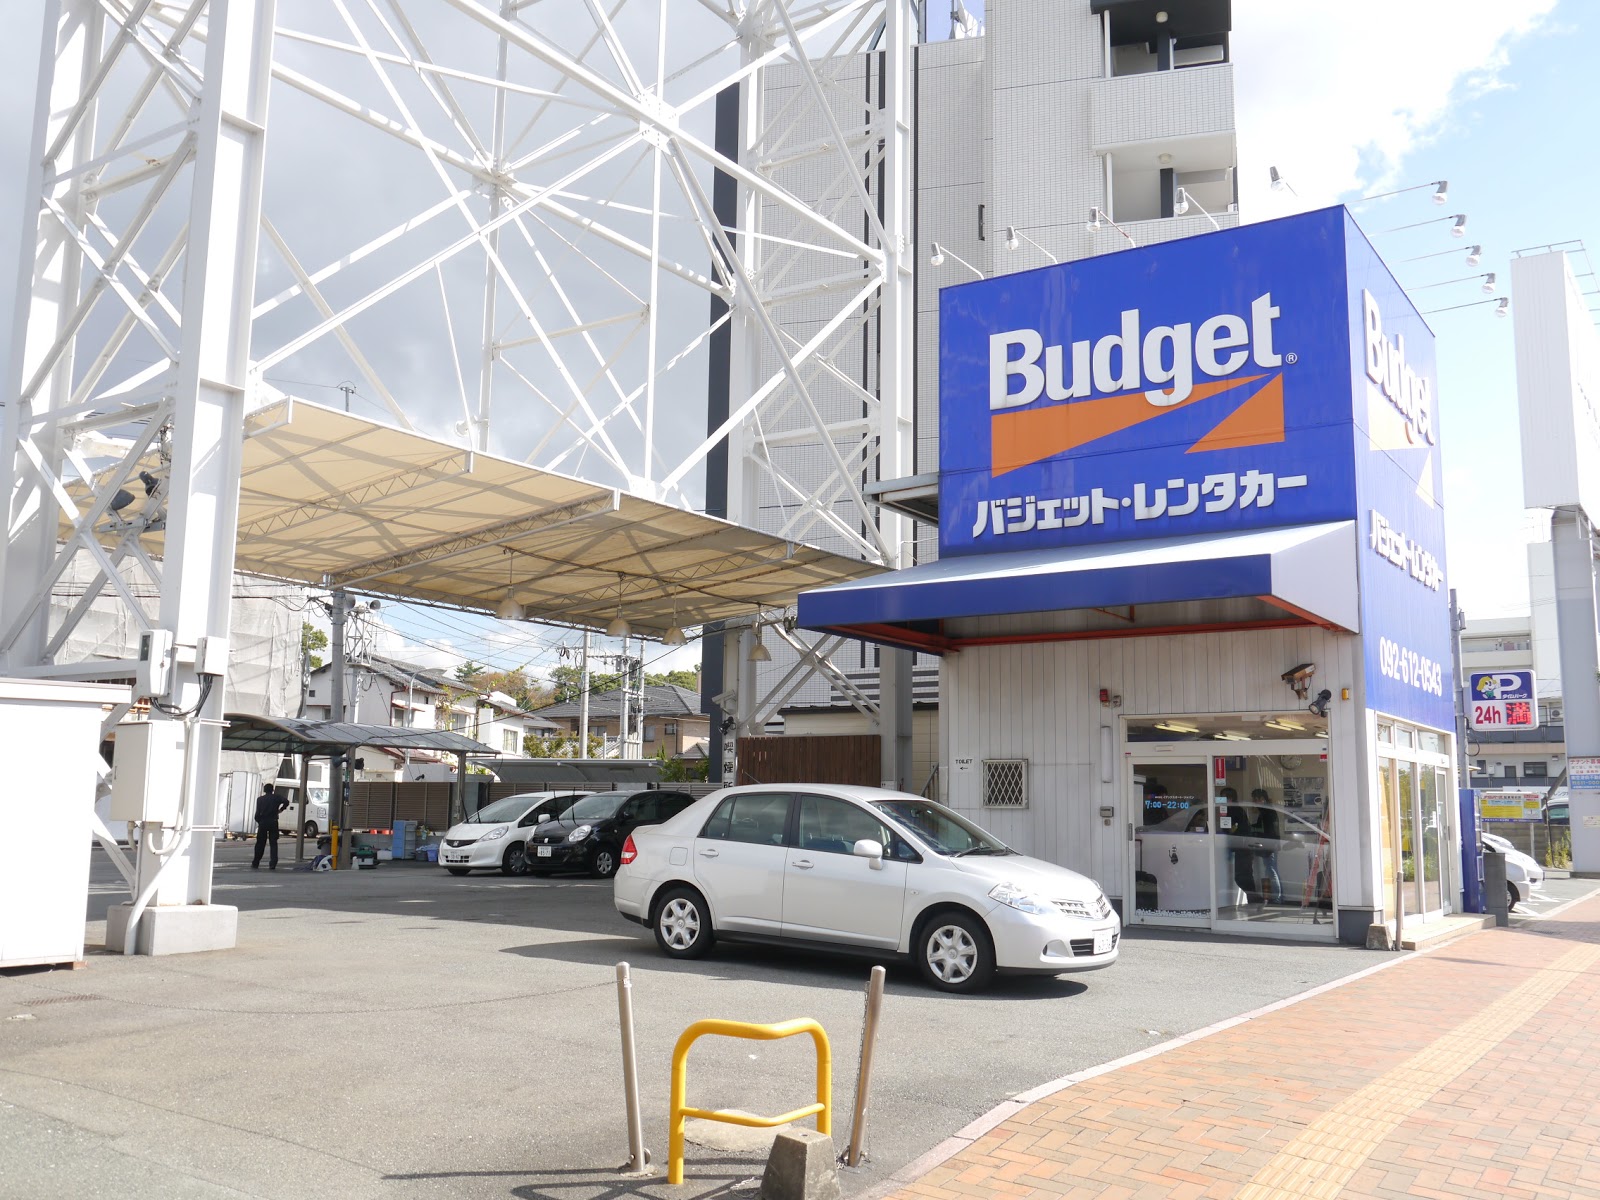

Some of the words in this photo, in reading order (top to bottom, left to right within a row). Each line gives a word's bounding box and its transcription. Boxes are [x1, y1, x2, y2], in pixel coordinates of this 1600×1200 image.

[988, 291, 1283, 411] Budget
[1362, 288, 1435, 446] Budget
[972, 469, 1308, 539] バジェット・レンタカー
[1379, 636, 1442, 697] 092-612-0543
[1475, 705, 1501, 724] 24h
